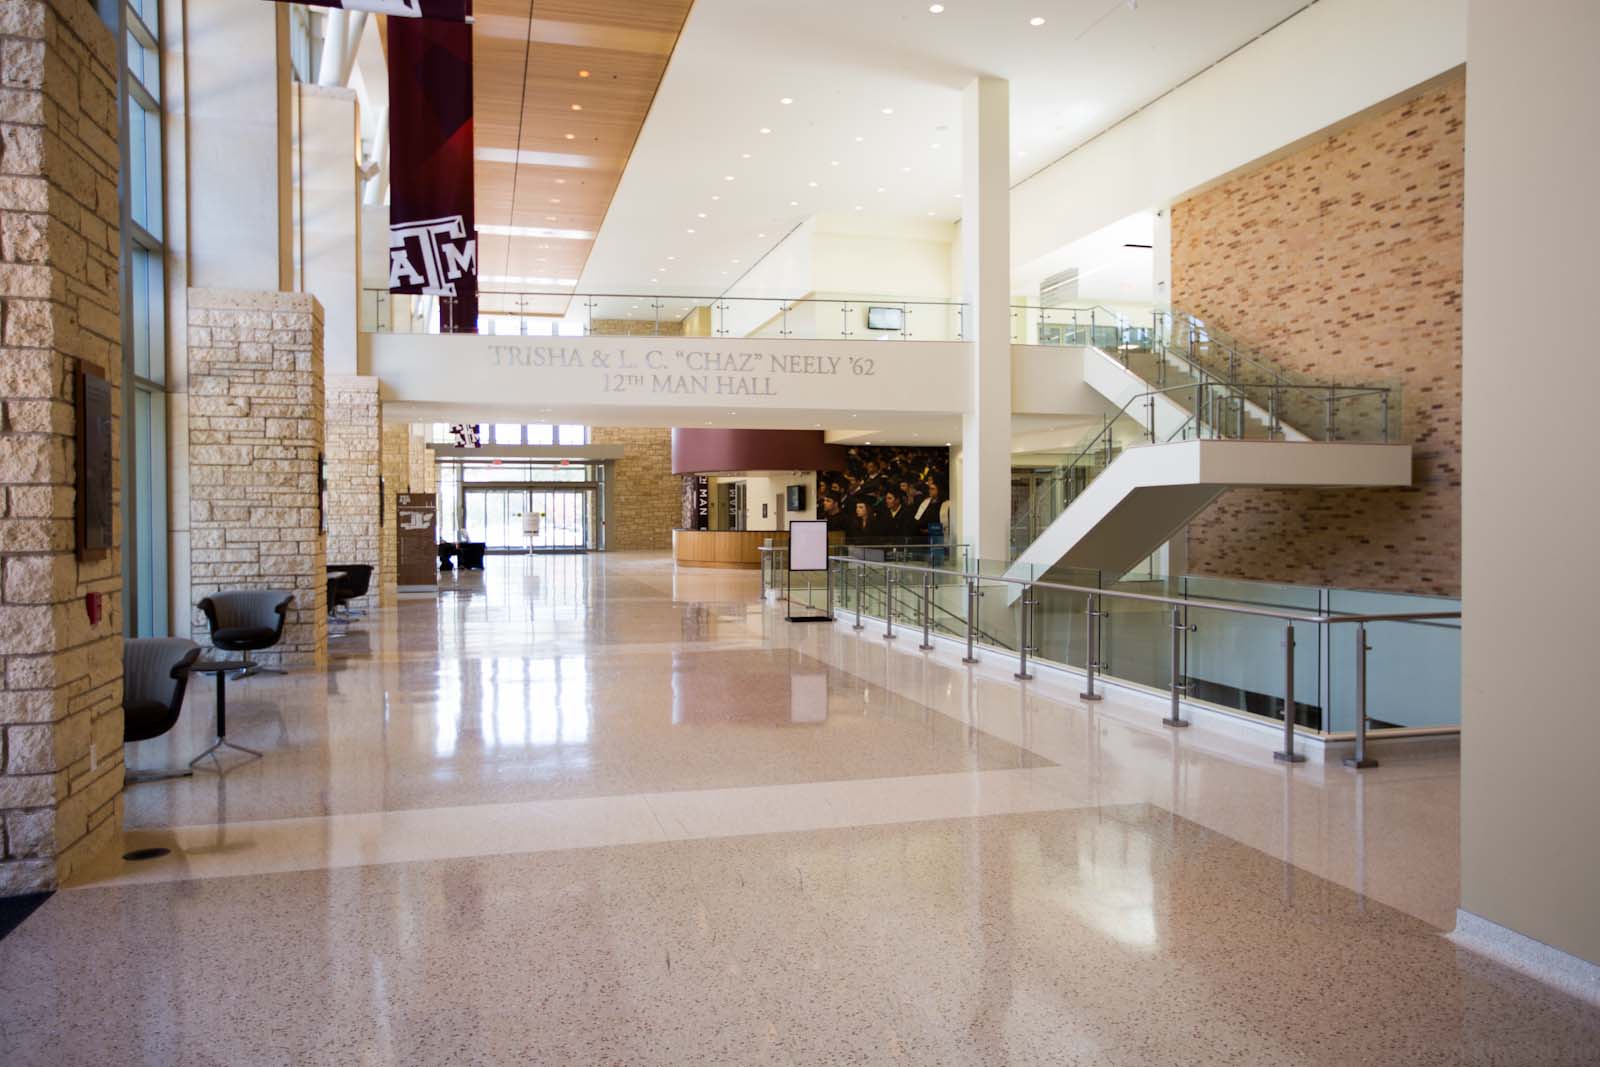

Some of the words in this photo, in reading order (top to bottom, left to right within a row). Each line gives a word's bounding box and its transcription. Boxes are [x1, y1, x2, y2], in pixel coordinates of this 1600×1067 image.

[487, 345, 584, 367] TRISHA
[592, 348, 611, 368] &
[616, 350, 639, 369] L.
[645, 350, 669, 370] C.
[770, 354, 841, 375] NEELY
[849, 357, 876, 376] '62
[602, 374, 645, 393] 12TH
[651, 375, 708, 394] MAN
[715, 376, 777, 396] HALL
[699, 489, 708, 515] MAN
